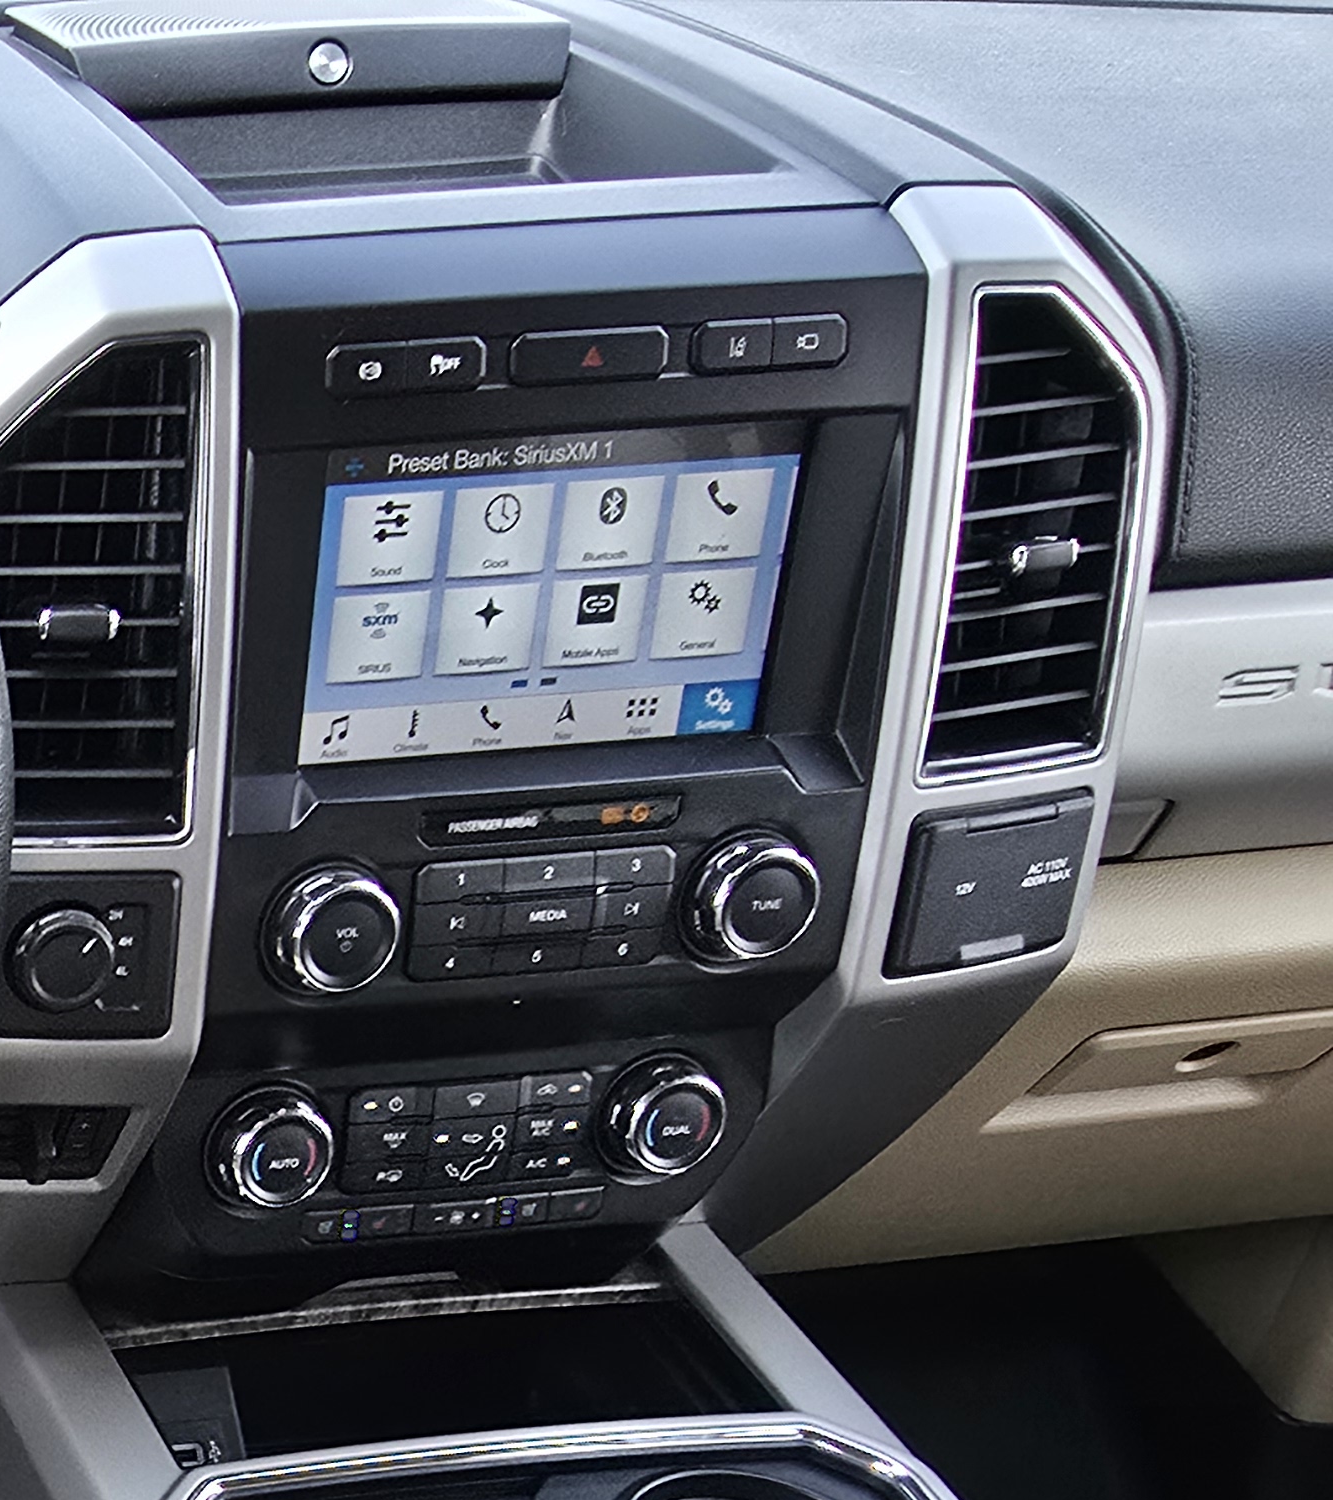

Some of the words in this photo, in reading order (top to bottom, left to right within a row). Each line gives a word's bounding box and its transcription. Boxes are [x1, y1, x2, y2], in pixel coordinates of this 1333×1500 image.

[388, 450, 449, 475] Preset
[454, 448, 510, 470] Bank:
[513, 440, 598, 466] SiriusXM
[604, 440, 614, 459] 1
[698, 543, 729, 554] Phone
[581, 550, 629, 562] Bluetooth
[482, 558, 510, 570] Clock
[370, 565, 404, 578] Sound
[362, 612, 400, 628] sxm
[678, 638, 718, 651] General
[561, 649, 594, 660] Mobile
[594, 646, 620, 659] Apps
[457, 655, 509, 668] Navigation
[627, 725, 653, 737] Apps
[392, 742, 430, 754] Climate
[471, 736, 503, 748] Phone
[320, 749, 349, 760] Audio
[448, 820, 503, 834] PASSENGER
[503, 816, 540, 830] AIRBAG
[631, 858, 642, 873] 3
[1026, 862, 1045, 875] AC
[543, 865, 555, 880] 2
[457, 873, 466, 887] 1
[955, 882, 977, 896] 12V
[751, 898, 783, 911] TUNE
[529, 909, 568, 923] MEDIA
[336, 926, 360, 939] VOL
[617, 942, 629, 956] 6
[444, 957, 455, 969] 4
[532, 950, 543, 964] 5
[529, 1118, 555, 1129] MAX
[383, 1131, 408, 1143] MAX
[531, 1126, 552, 1138] A/C
[662, 1125, 691, 1137] DUAL
[268, 1158, 300, 1170] AUTO
[526, 1157, 549, 1169] A/C
